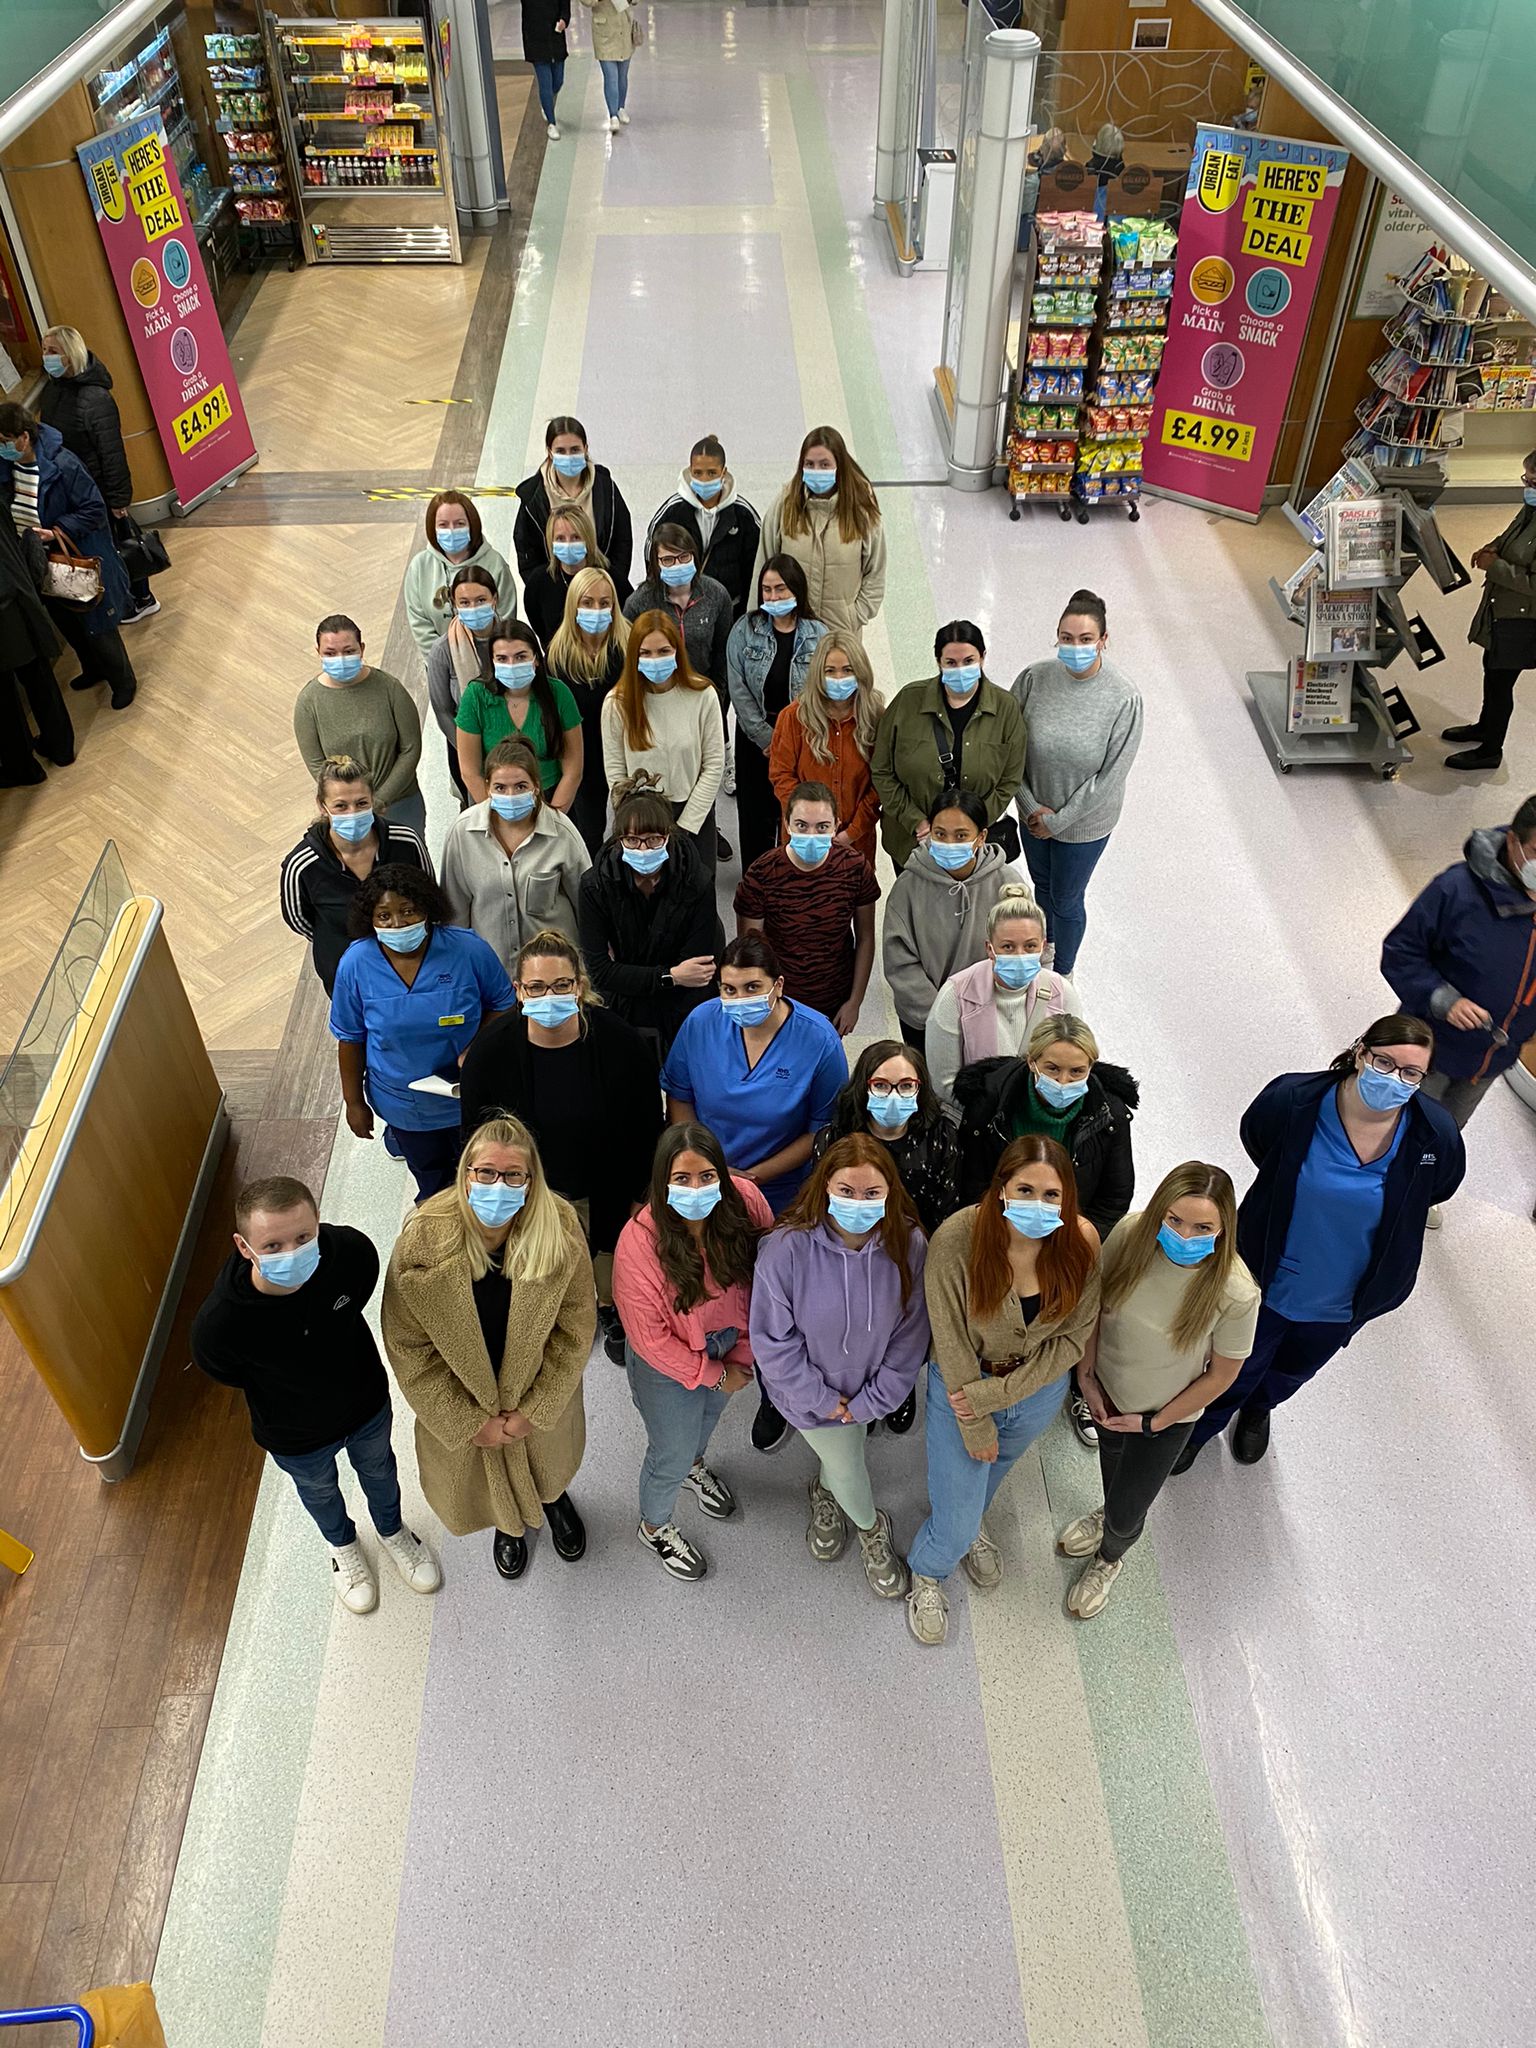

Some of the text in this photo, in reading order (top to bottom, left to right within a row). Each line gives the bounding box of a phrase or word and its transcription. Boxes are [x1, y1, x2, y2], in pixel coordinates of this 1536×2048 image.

[129, 139, 161, 176] HERE'S
[1204, 155, 1222, 190] URBAN
[1264, 166, 1320, 193] HERE'S
[95, 168, 112, 204] URBAN
[133, 174, 166, 206] THE
[145, 206, 179, 235] DEAL
[1252, 197, 1305, 226] THE
[1388, 207, 1413, 218] vital
[1384, 221, 1416, 232] older
[1248, 229, 1302, 259] DEAL
[145, 308, 159, 322] Pick
[177, 293, 201, 319] SNACK
[1191, 304, 1211, 316] Pick
[144, 312, 172, 338] MAIN
[1181, 313, 1225, 333] MAIN
[1239, 314, 1274, 330] Choose
[1238, 325, 1279, 347] SNACK
[181, 376, 209, 403] DRINK
[1201, 387, 1223, 399] Grab
[1192, 395, 1236, 416] DRINK
[181, 396, 220, 444] £4.99
[1171, 417, 1239, 451] £4.99
